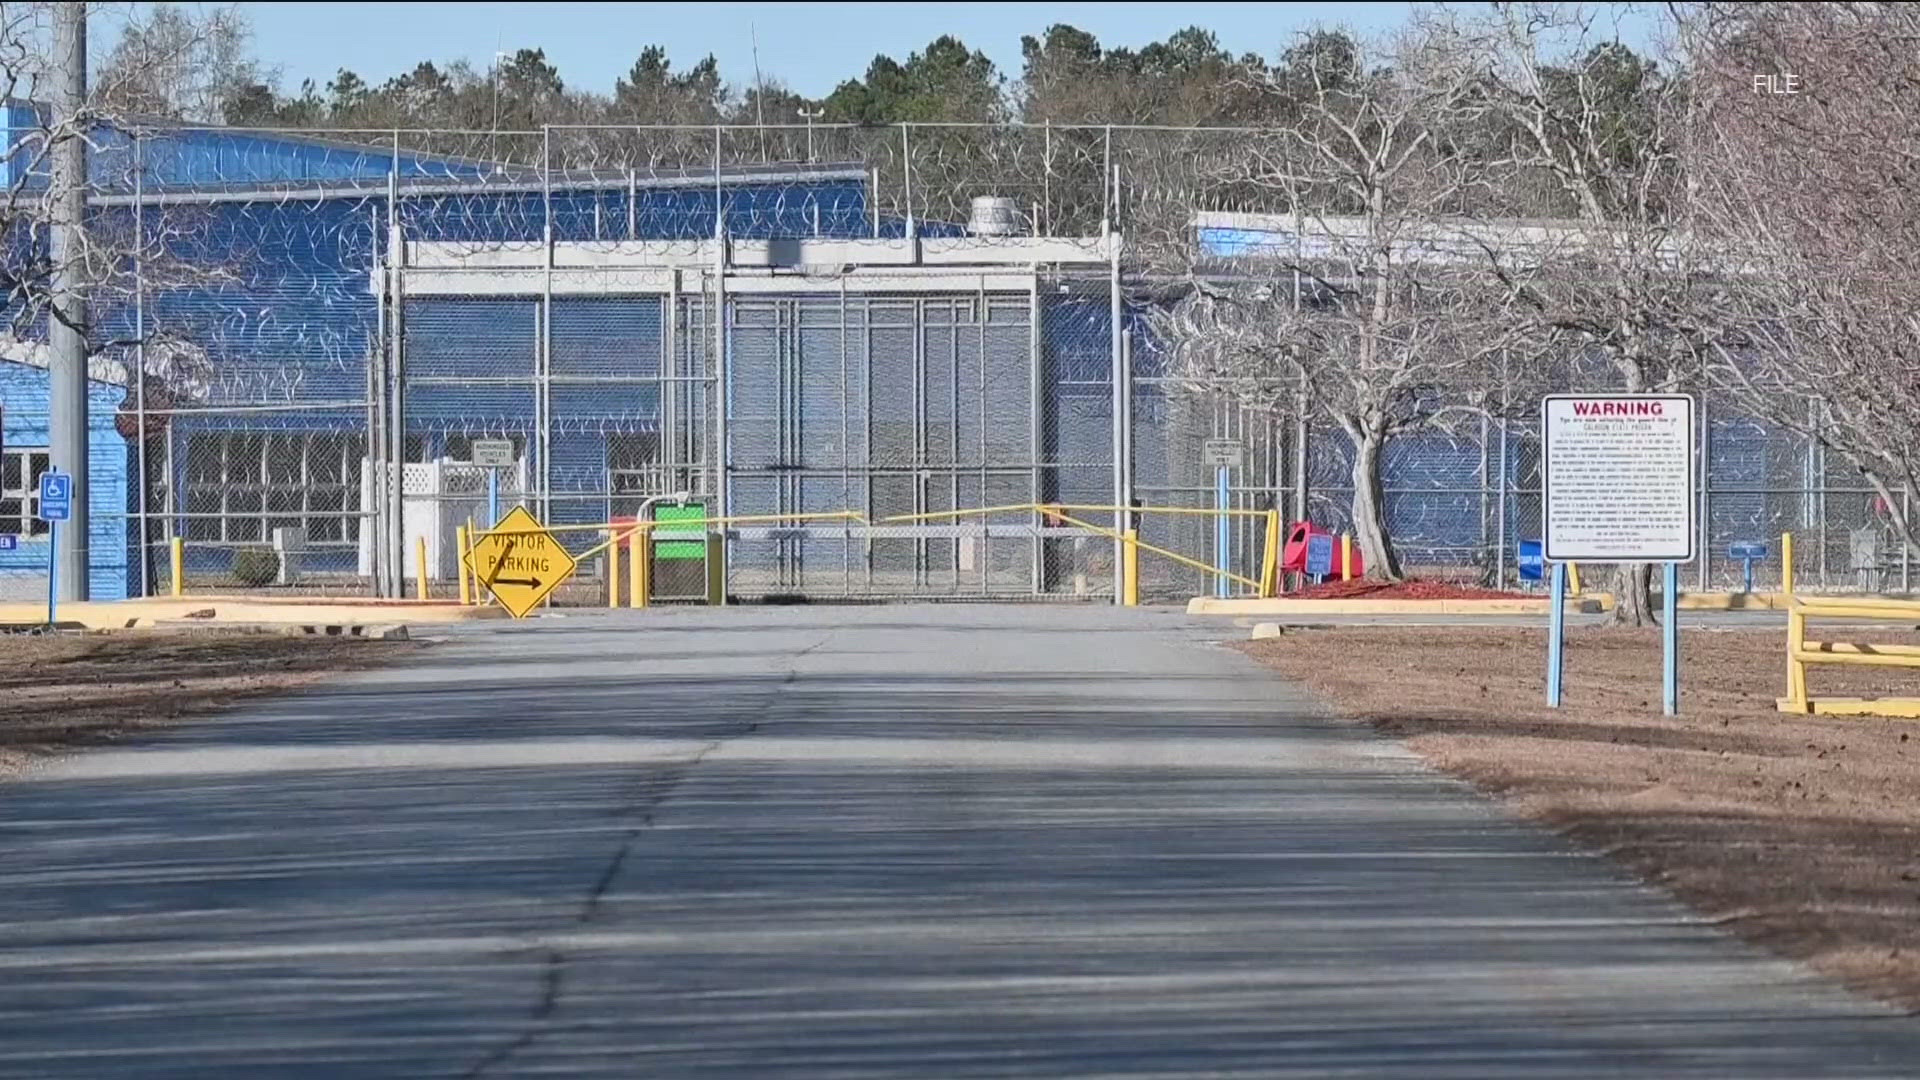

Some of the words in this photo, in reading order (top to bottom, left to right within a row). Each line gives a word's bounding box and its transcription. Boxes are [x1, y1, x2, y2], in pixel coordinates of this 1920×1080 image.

[1573, 402, 1663, 415] WARNING
[493, 534, 545, 550] VISITOR
[488, 554, 549, 572] PARKING
